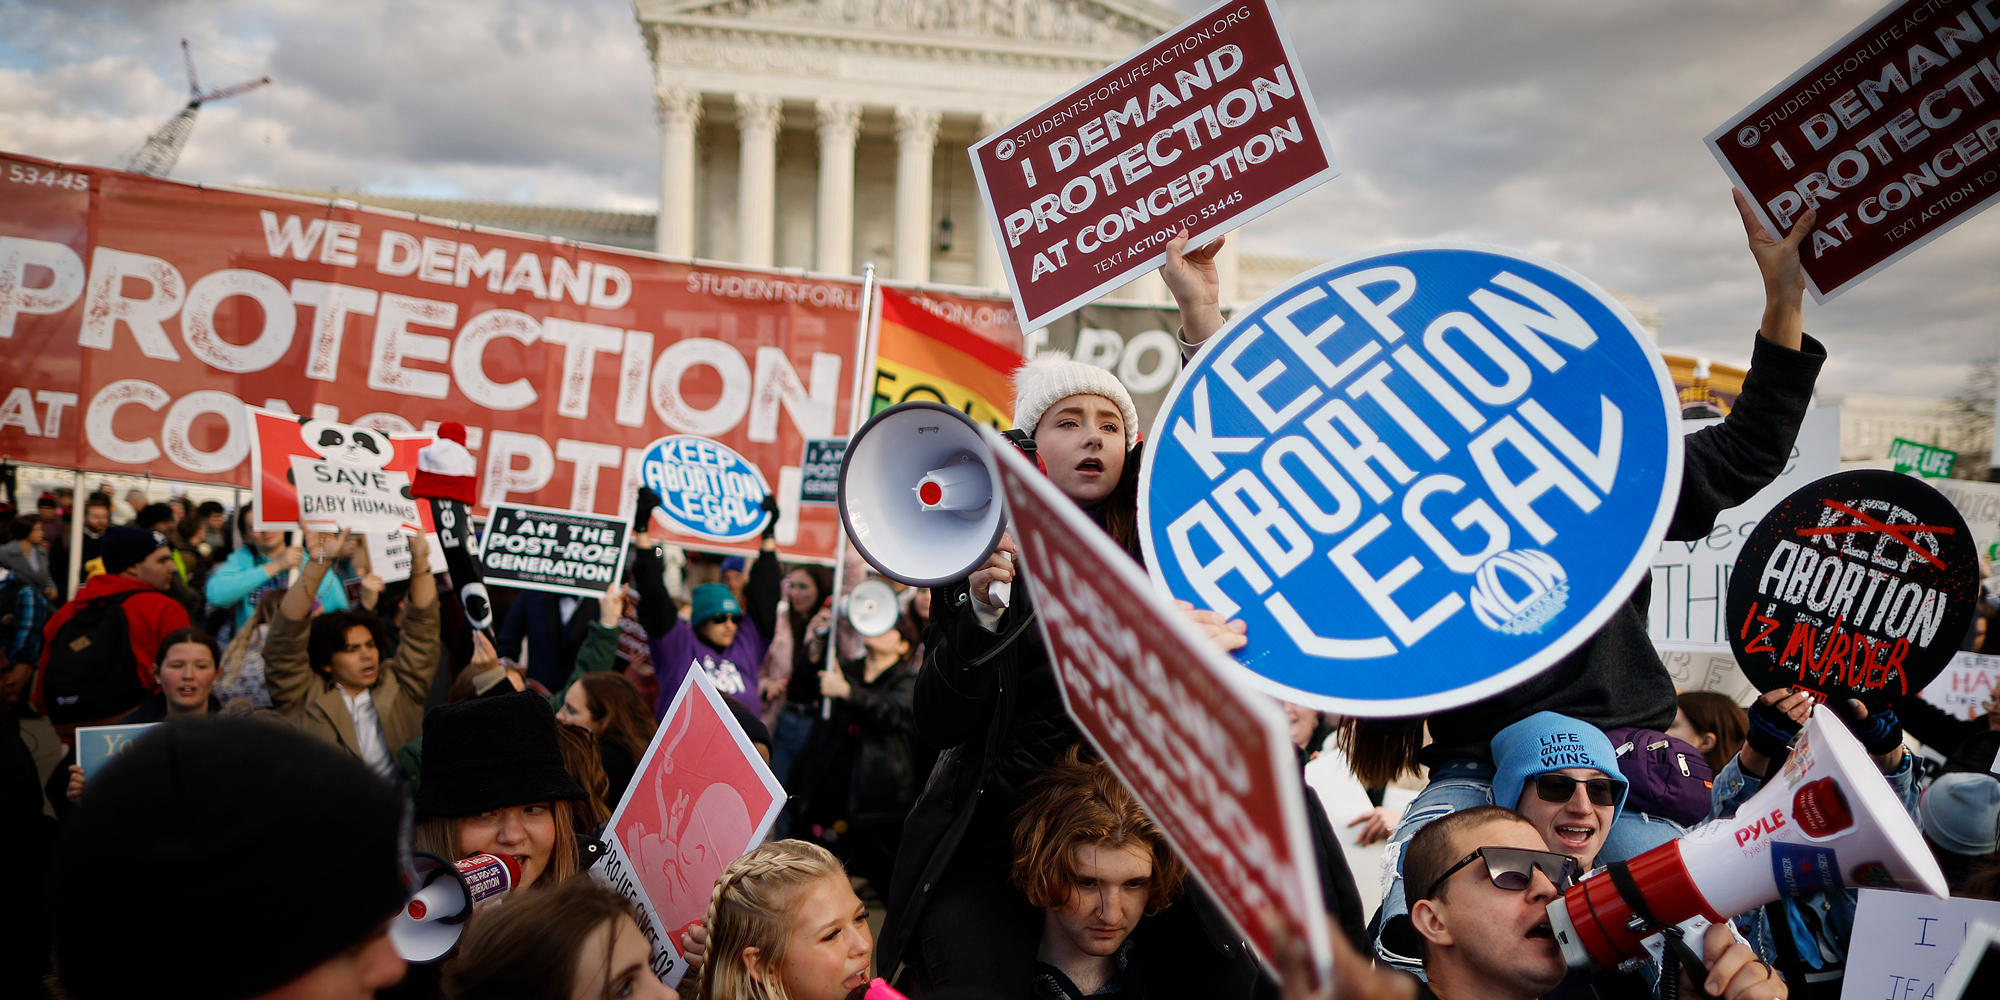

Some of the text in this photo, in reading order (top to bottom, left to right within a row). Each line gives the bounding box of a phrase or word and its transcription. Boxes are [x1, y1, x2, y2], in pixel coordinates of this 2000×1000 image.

[1016, 6, 1250, 148] STUDENTSFORLIFEACTION.ORG
[1021, 44, 1244, 188] I DEMAND
[1767, 52, 2000, 230] PROTECTI
[9, 163, 90, 191] 53445
[1003, 64, 1296, 248] PROTECTION
[1771, 141, 1796, 171] I
[1030, 116, 1304, 283] AT CONCEPTION
[1884, 169, 1998, 242] TEXT ACTION TO
[1093, 191, 1243, 274] TEXT ACTION TO 53445
[1812, 212, 1853, 259] AT
[260, 209, 633, 311] WE DEMAND
[0, 236, 842, 445] PROTECTION
[1173, 266, 1417, 480] KEEP
[0, 387, 79, 438] AT
[660, 440, 737, 470] KEEP
[1166, 270, 1599, 618] ABORTION
[1921, 449, 1955, 476] LIFE
[313, 463, 391, 494] SAVE
[645, 459, 765, 503] ABORTION
[303, 494, 416, 521] BABY HUMANS
[438, 498, 460, 549] Pea
[499, 516, 509, 533] I
[516, 519, 559, 539] AM
[567, 524, 616, 545] THE
[661, 488, 759, 527] LEGAL
[1264, 394, 1624, 659] LEGAL
[487, 531, 621, 566] POST-ROE
[1810, 499, 1940, 574] KEEP
[485, 551, 614, 584] GENERATION
[1470, 548, 1569, 632] NOW
[1758, 539, 1948, 648] ABORTION
[1778, 614, 1910, 697] MURDER
[1540, 733, 1580, 746] LIFE
[1541, 744, 1585, 756] always
[1734, 808, 1787, 848] PYLE
[1741, 827, 1793, 859] PyleUSA.com
[1914, 917, 1939, 947] I
